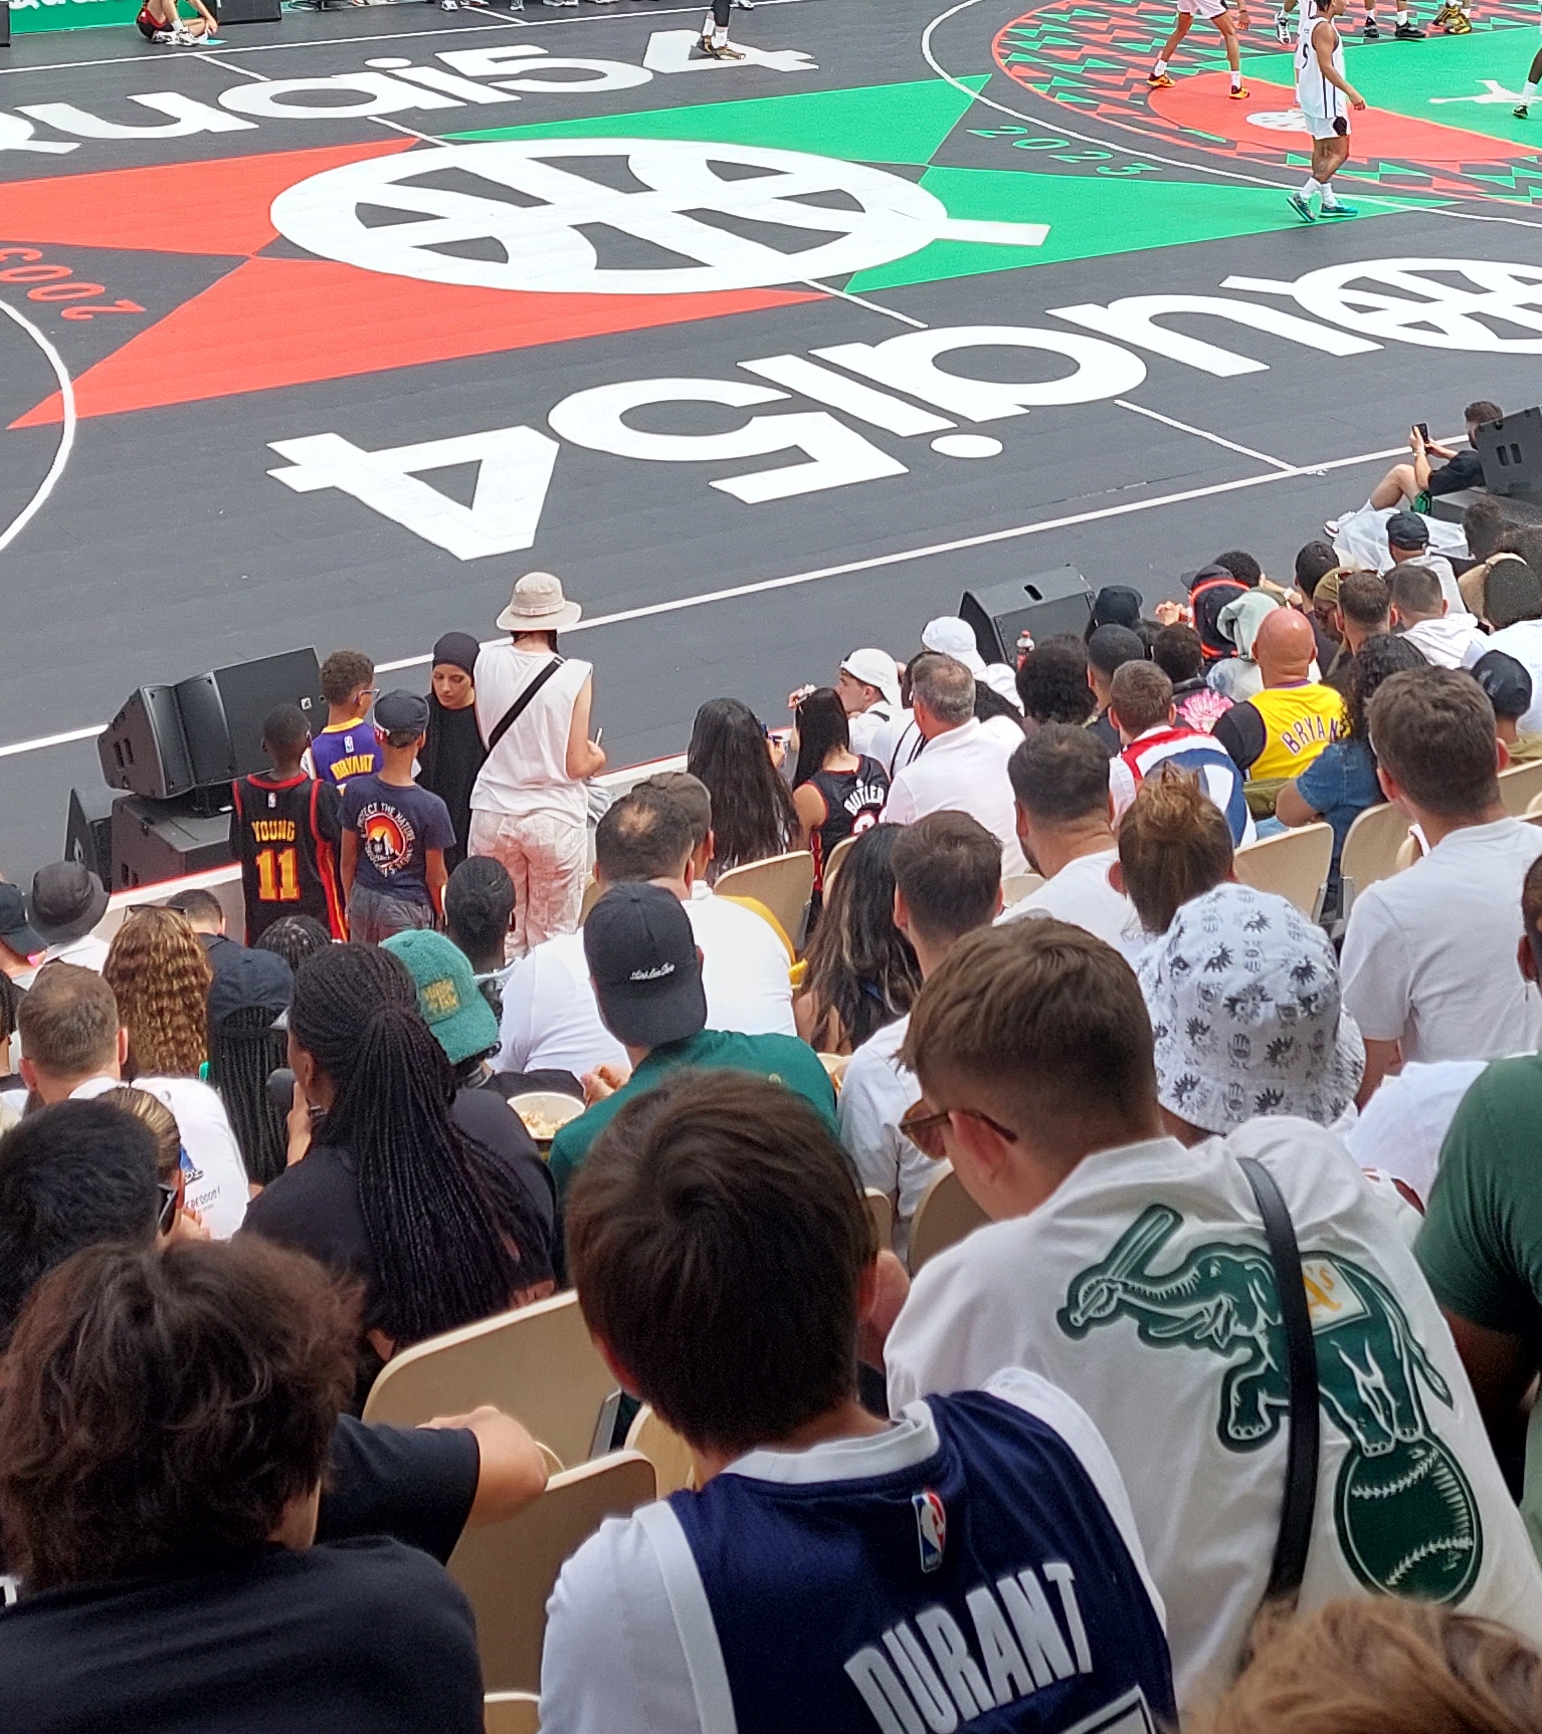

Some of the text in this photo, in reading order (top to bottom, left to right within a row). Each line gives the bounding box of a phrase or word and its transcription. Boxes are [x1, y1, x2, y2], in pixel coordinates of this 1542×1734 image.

[966, 124, 1162, 177] 2023
[1281, 714, 1339, 757] BRYAN
[330, 753, 375, 780] BRYANT
[380, 802, 396, 816] THE
[251, 819, 296, 843] YOUNG
[255, 847, 301, 901] 11
[843, 1562, 1093, 1734] DURANT
